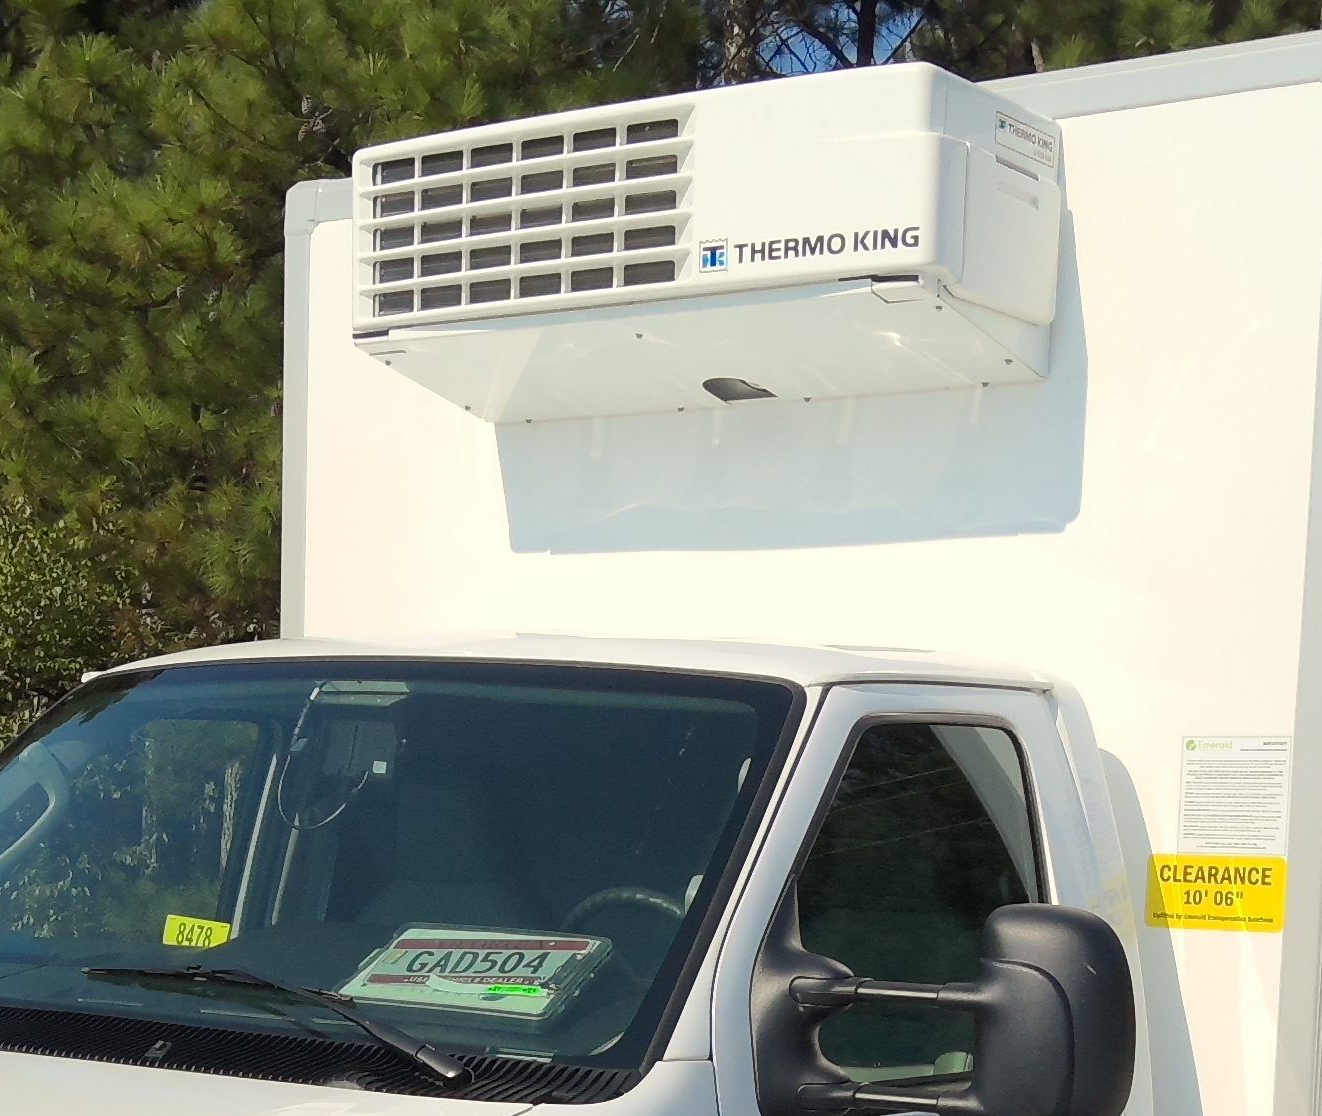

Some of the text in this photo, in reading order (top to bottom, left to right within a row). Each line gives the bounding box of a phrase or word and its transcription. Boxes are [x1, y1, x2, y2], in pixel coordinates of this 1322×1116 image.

[1008, 123, 1053, 153] THERMO KING
[733, 226, 920, 264] THERMO KING
[1198, 740, 1233, 750] Emerald
[1159, 864, 1273, 886] CLEARANCE
[1183, 889, 1244, 907] 10' 06"
[175, 922, 213, 948] 8478
[405, 950, 551, 975] GAD504
[482, 977, 524, 985] DEALER
